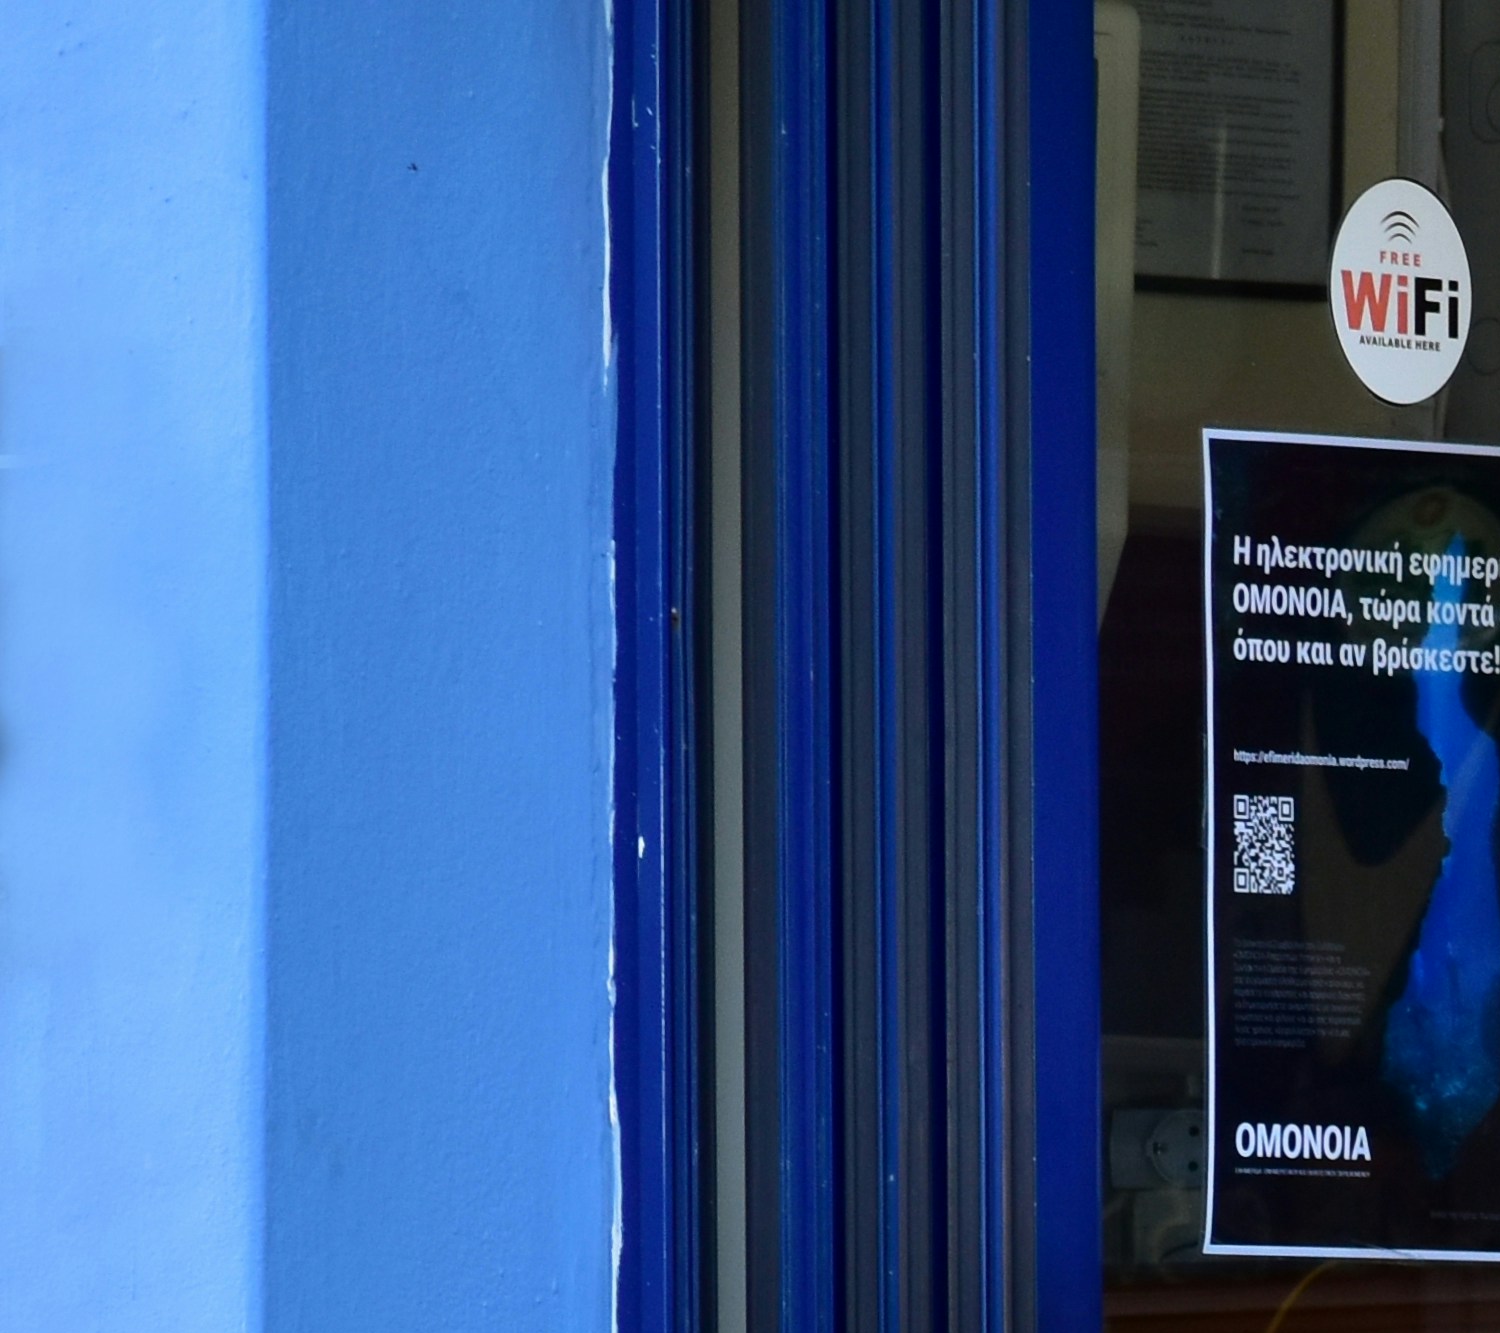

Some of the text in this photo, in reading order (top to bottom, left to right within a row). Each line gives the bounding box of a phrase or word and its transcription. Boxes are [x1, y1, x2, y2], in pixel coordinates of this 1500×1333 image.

[1379, 251, 1422, 268] FREE
[1341, 269, 1459, 340] WiFi
[1359, 335, 1442, 352] AVAILABLE HERE
[1233, 535, 1251, 566] Η
[1256, 536, 1403, 583] ηλεκτρονική
[1359, 589, 1421, 630] τώρα
[1427, 594, 1495, 628] κοντά
[1232, 628, 1500, 677] όπου και αν βρίσκεστε!
[1235, 1122, 1371, 1163] ΟΜΟΝΟΙΑ
